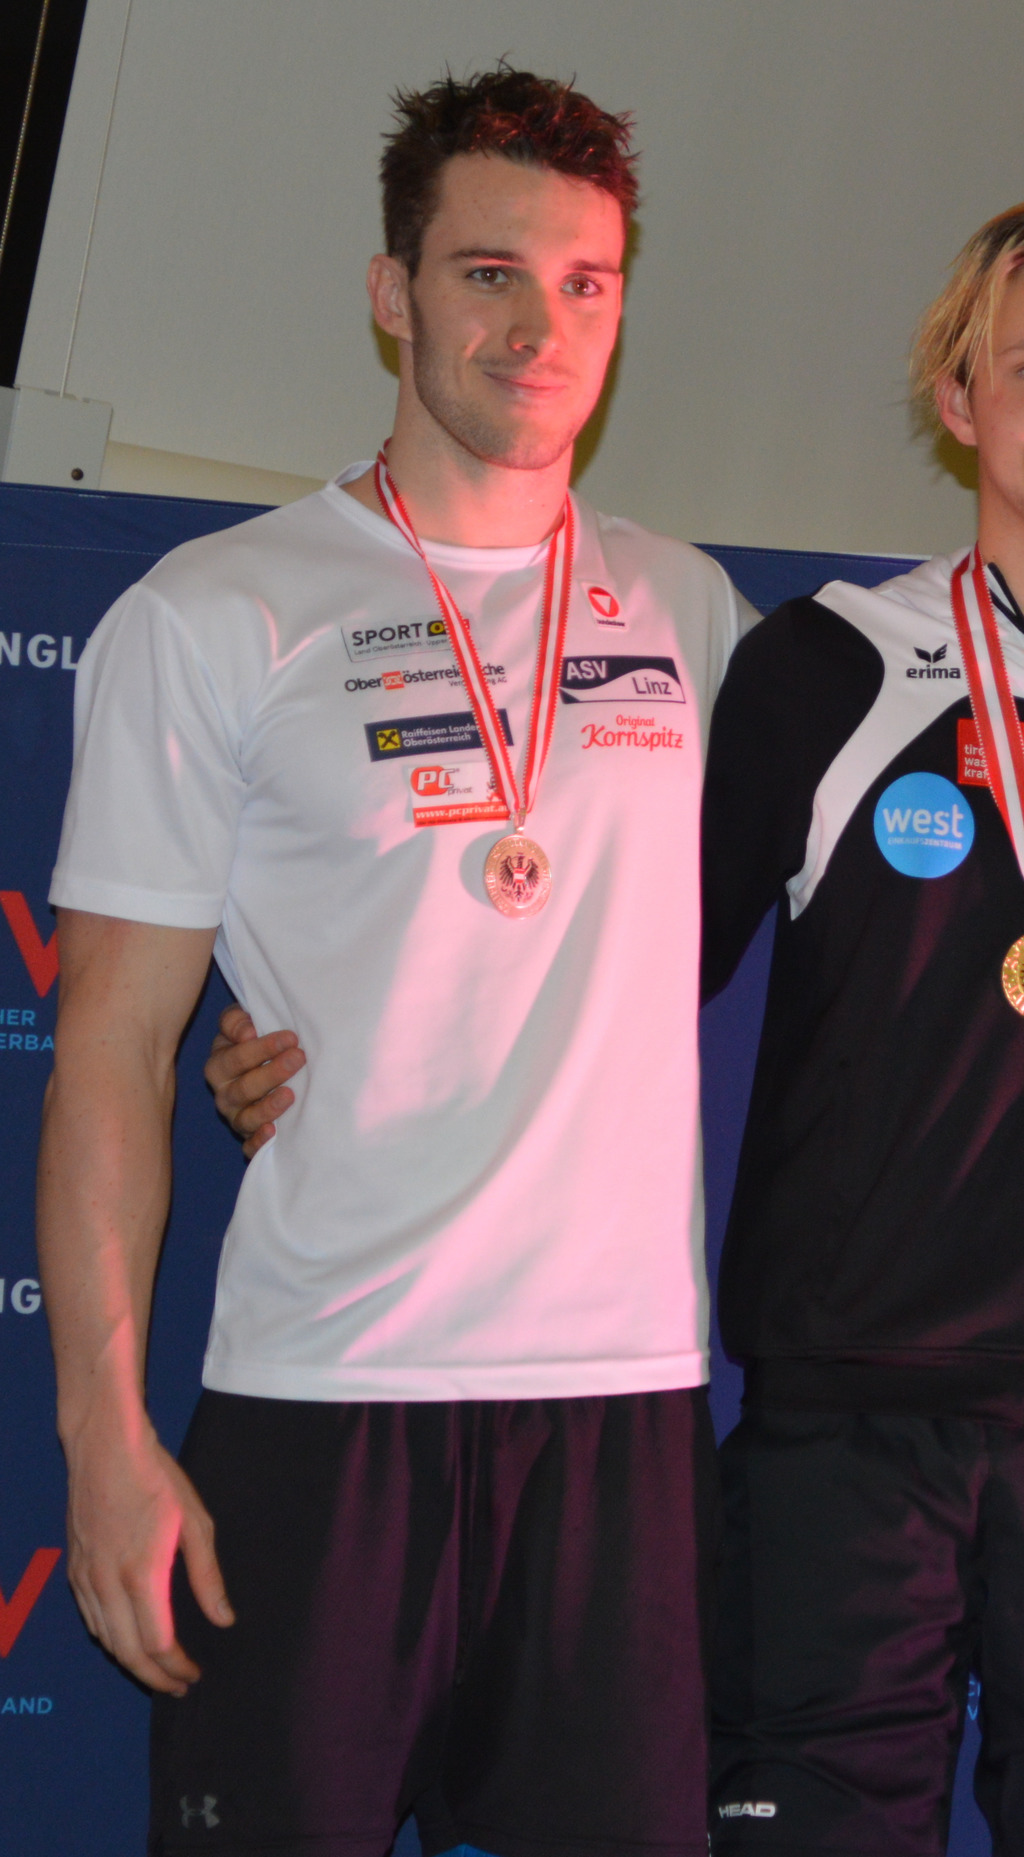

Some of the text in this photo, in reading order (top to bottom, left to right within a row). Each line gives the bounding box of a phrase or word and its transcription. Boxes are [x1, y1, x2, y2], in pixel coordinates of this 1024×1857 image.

[352, 623, 422, 646] SPORT
[0, 631, 90, 670] NGL
[566, 660, 609, 681] ASV
[906, 664, 961, 679] erima
[631, 676, 673, 696] Linz
[401, 723, 480, 738] Raiffeisen Lande
[615, 713, 655, 730] Original
[403, 733, 472, 748] Oberösterreich
[580, 722, 684, 752] Kornspitz
[964, 756, 987, 768] was
[417, 768, 456, 791] PC
[964, 766, 989, 779] kraf
[882, 803, 965, 838] west
[0, 1032, 55, 1052] ERBA
[1, 1697, 54, 1715] AND
[718, 1801, 777, 1819] HEAD
